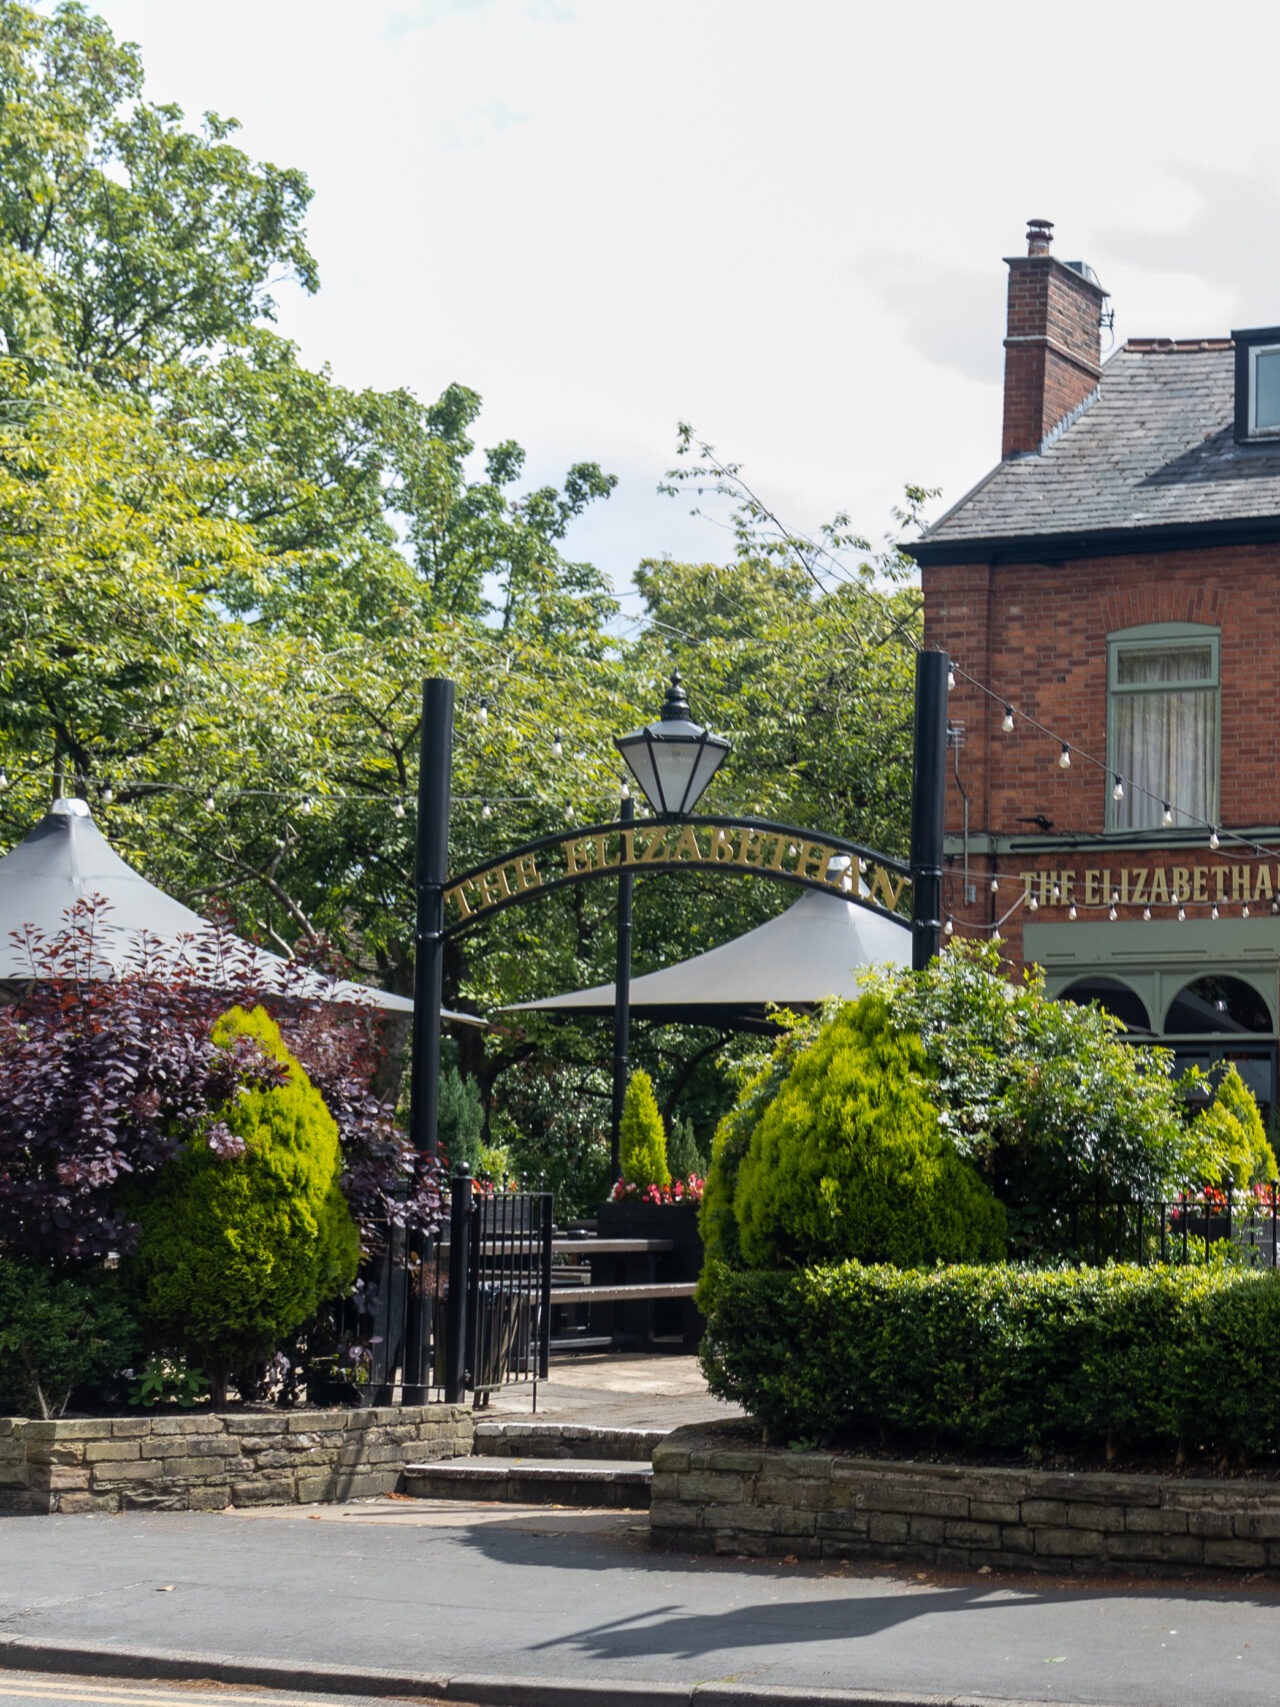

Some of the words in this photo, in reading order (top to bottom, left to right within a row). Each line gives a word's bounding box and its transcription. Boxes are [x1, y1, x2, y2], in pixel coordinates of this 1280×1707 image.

[443, 852, 543, 922] THE
[560, 824, 912, 911] ELIZABETHAN
[1020, 870, 1076, 906] THE
